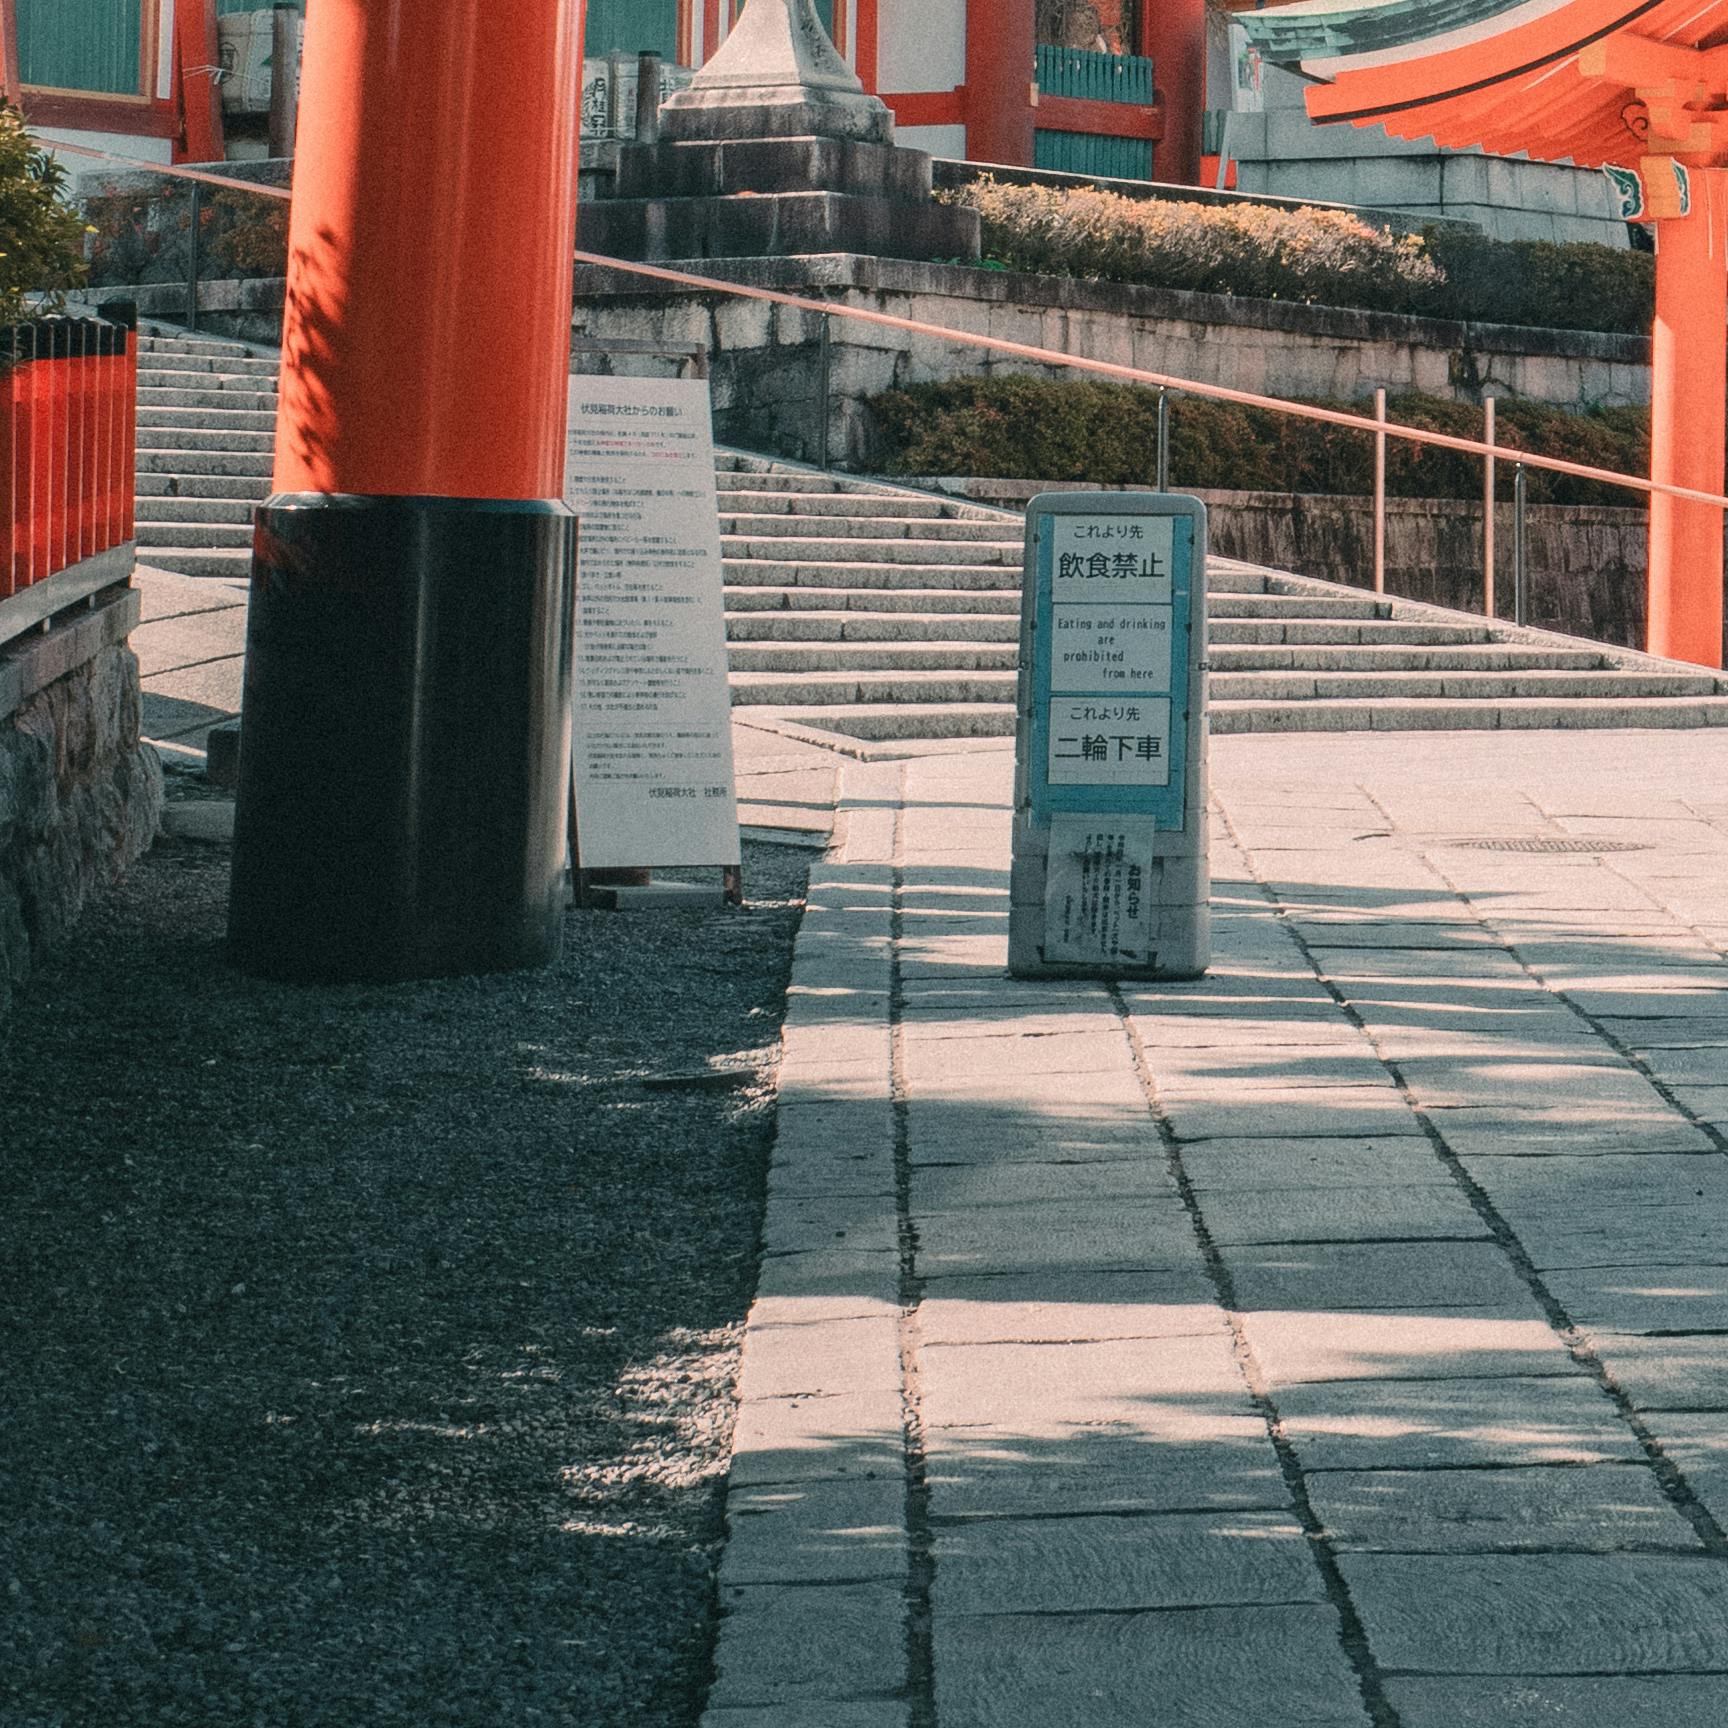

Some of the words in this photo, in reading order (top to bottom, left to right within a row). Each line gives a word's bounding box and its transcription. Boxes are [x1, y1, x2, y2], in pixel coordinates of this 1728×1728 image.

[1074, 525, 1144, 539] これより先
[1058, 552, 1165, 579] 飲食禁止
[1058, 618, 1092, 630] Eating
[1097, 618, 1115, 630] and
[1119, 618, 1166, 631] drinking
[1097, 636, 1115, 645] are
[1063, 650, 1124, 663] prohibited
[1103, 667, 1126, 679] from
[1131, 667, 1154, 679] here
[1070, 707, 1141, 721] これより先
[1054, 734, 1162, 762] 二輪下車
[1127, 864, 1142, 919] お知らせ
